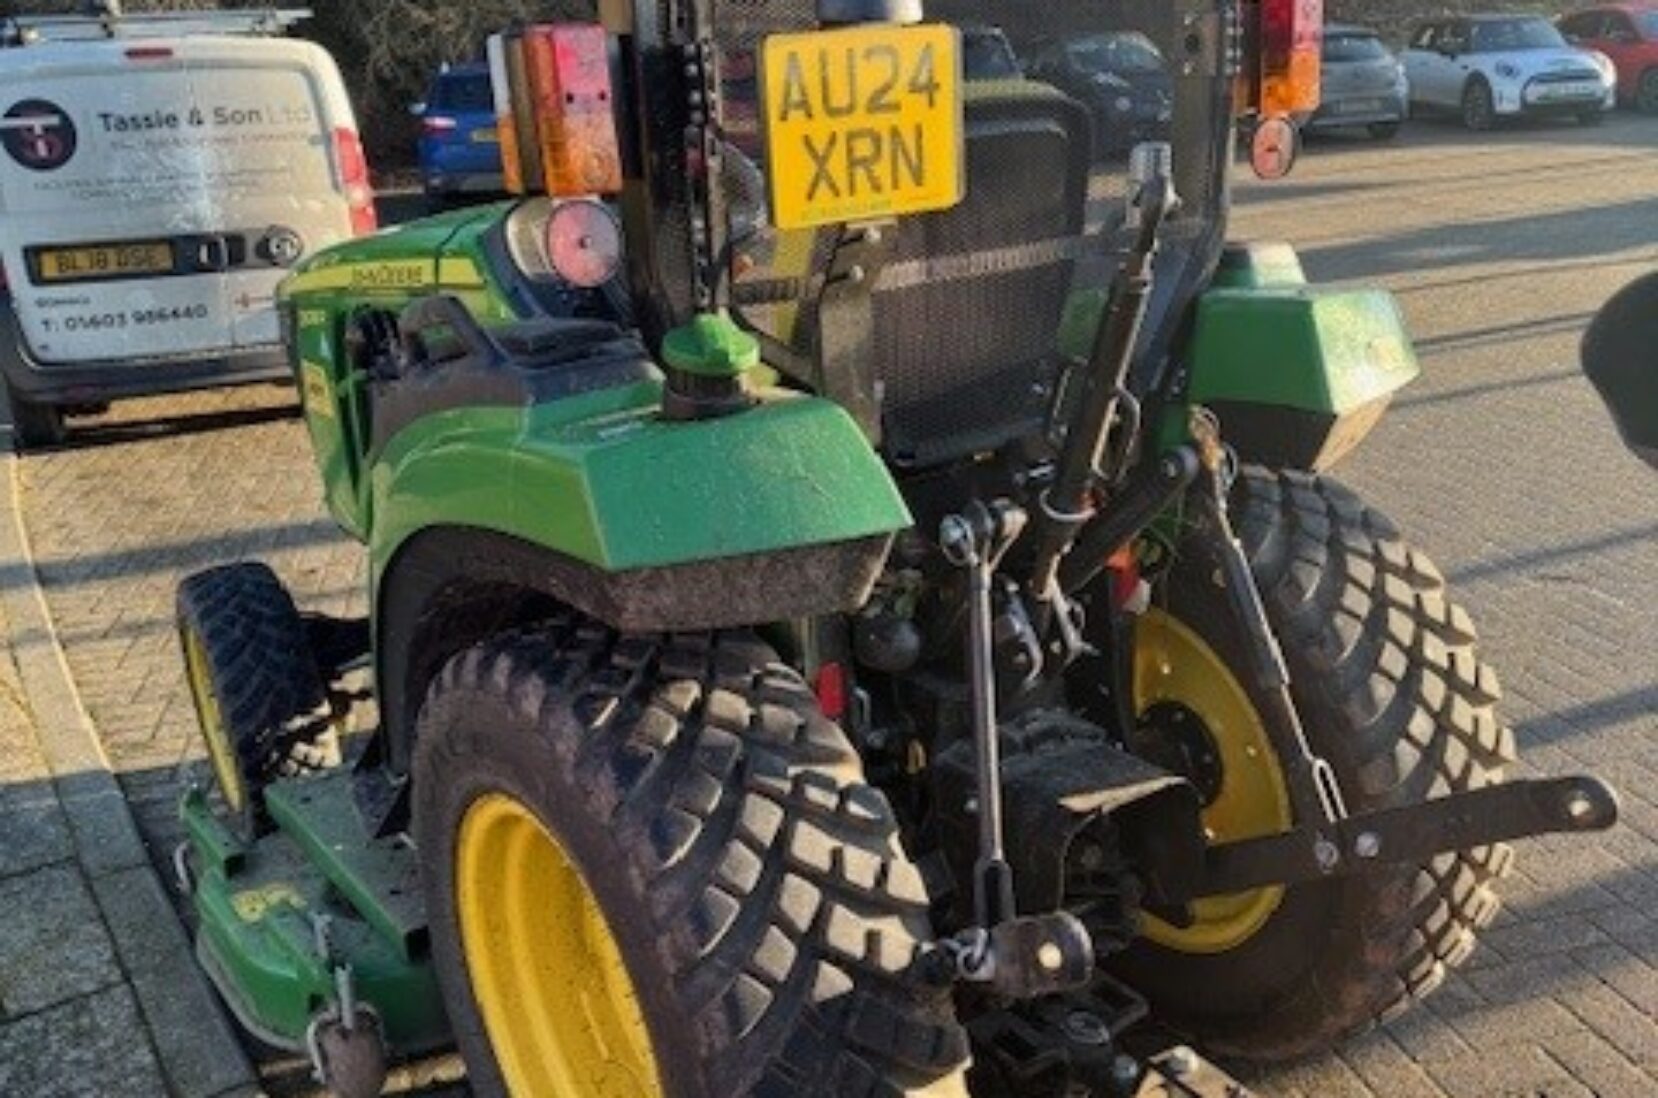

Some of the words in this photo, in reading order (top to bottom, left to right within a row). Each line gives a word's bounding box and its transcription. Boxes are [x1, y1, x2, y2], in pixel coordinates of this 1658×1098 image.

[97, 109, 178, 132] Tassie
[189, 106, 204, 127] &
[213, 106, 262, 126] Son
[779, 42, 940, 121] AU24
[803, 123, 924, 200] XRN
